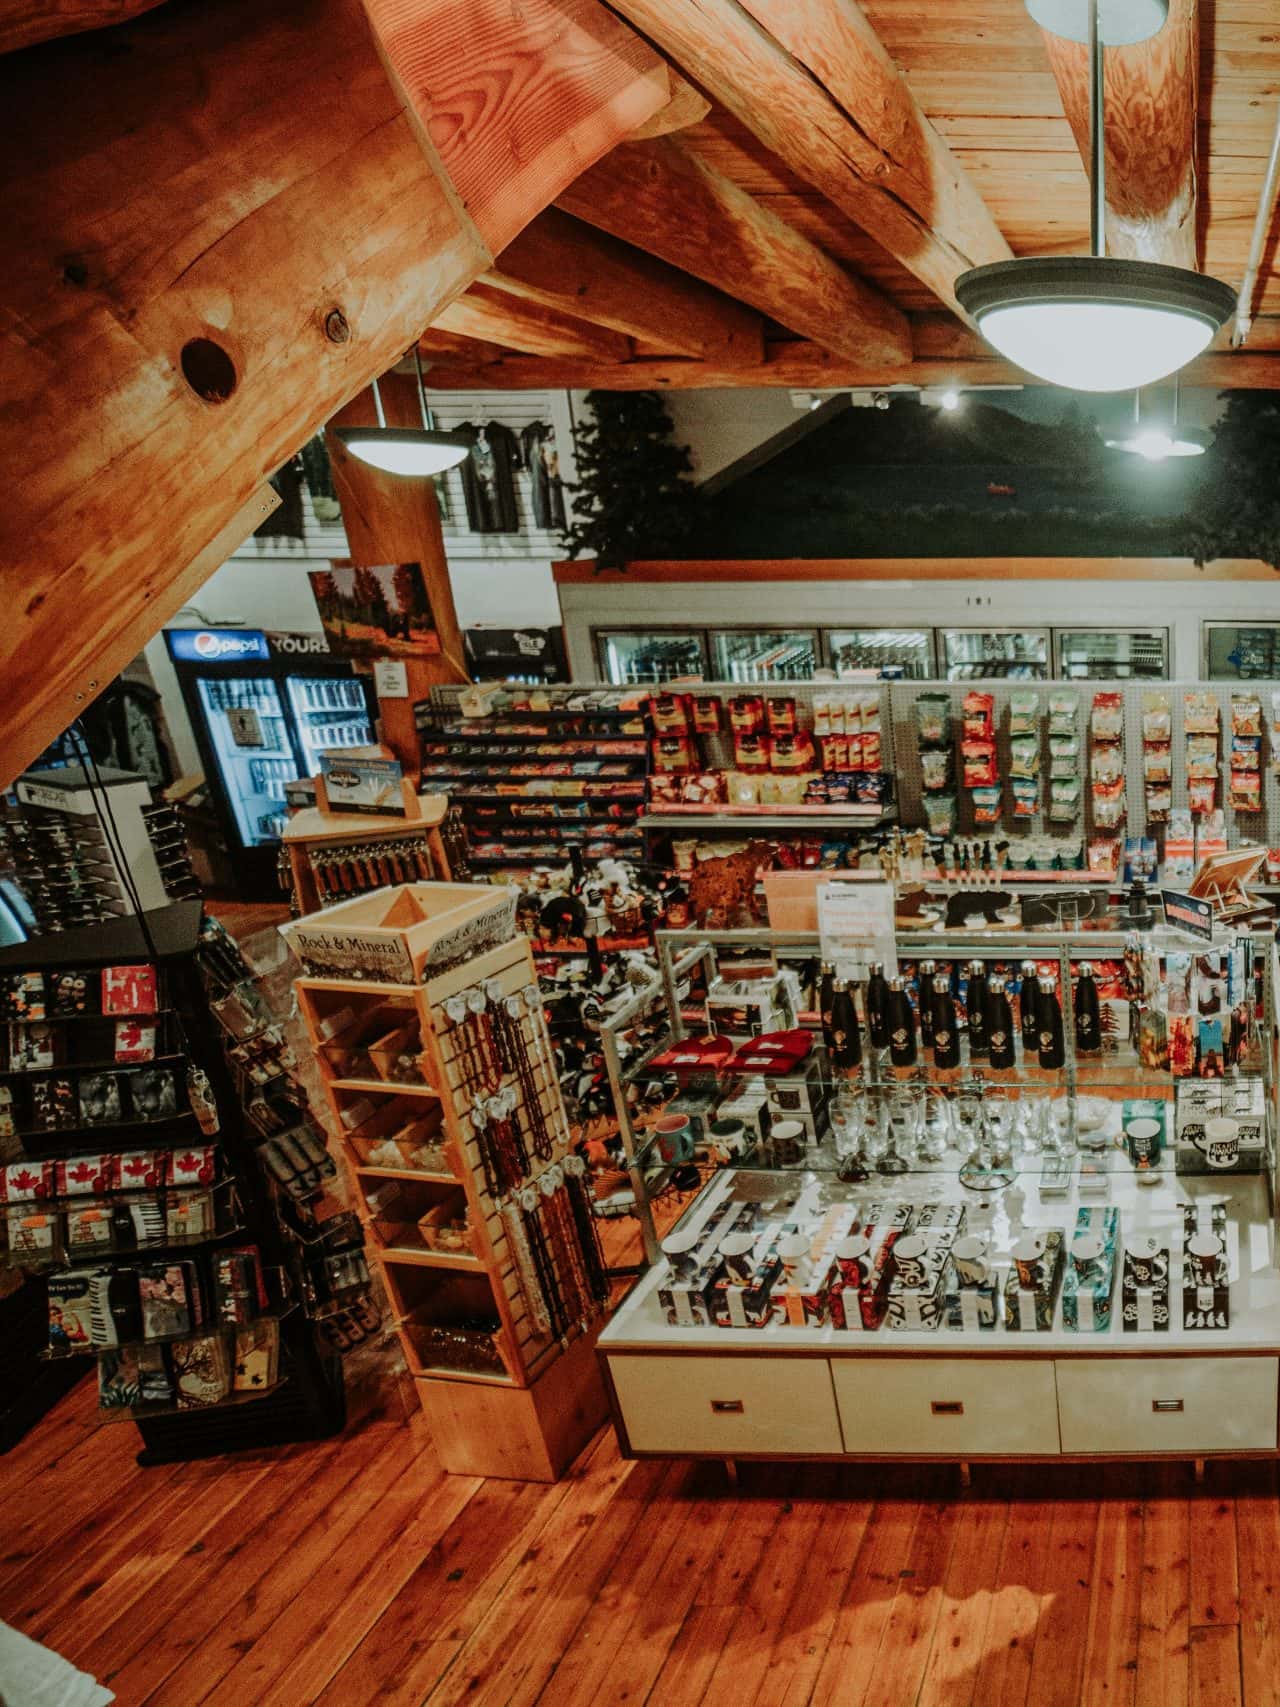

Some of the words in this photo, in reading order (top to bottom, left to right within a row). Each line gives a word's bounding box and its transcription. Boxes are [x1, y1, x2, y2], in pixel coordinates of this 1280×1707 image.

[297, 934, 332, 950] Rock
[332, 937, 345, 951] &
[347, 937, 400, 954] Mineral
